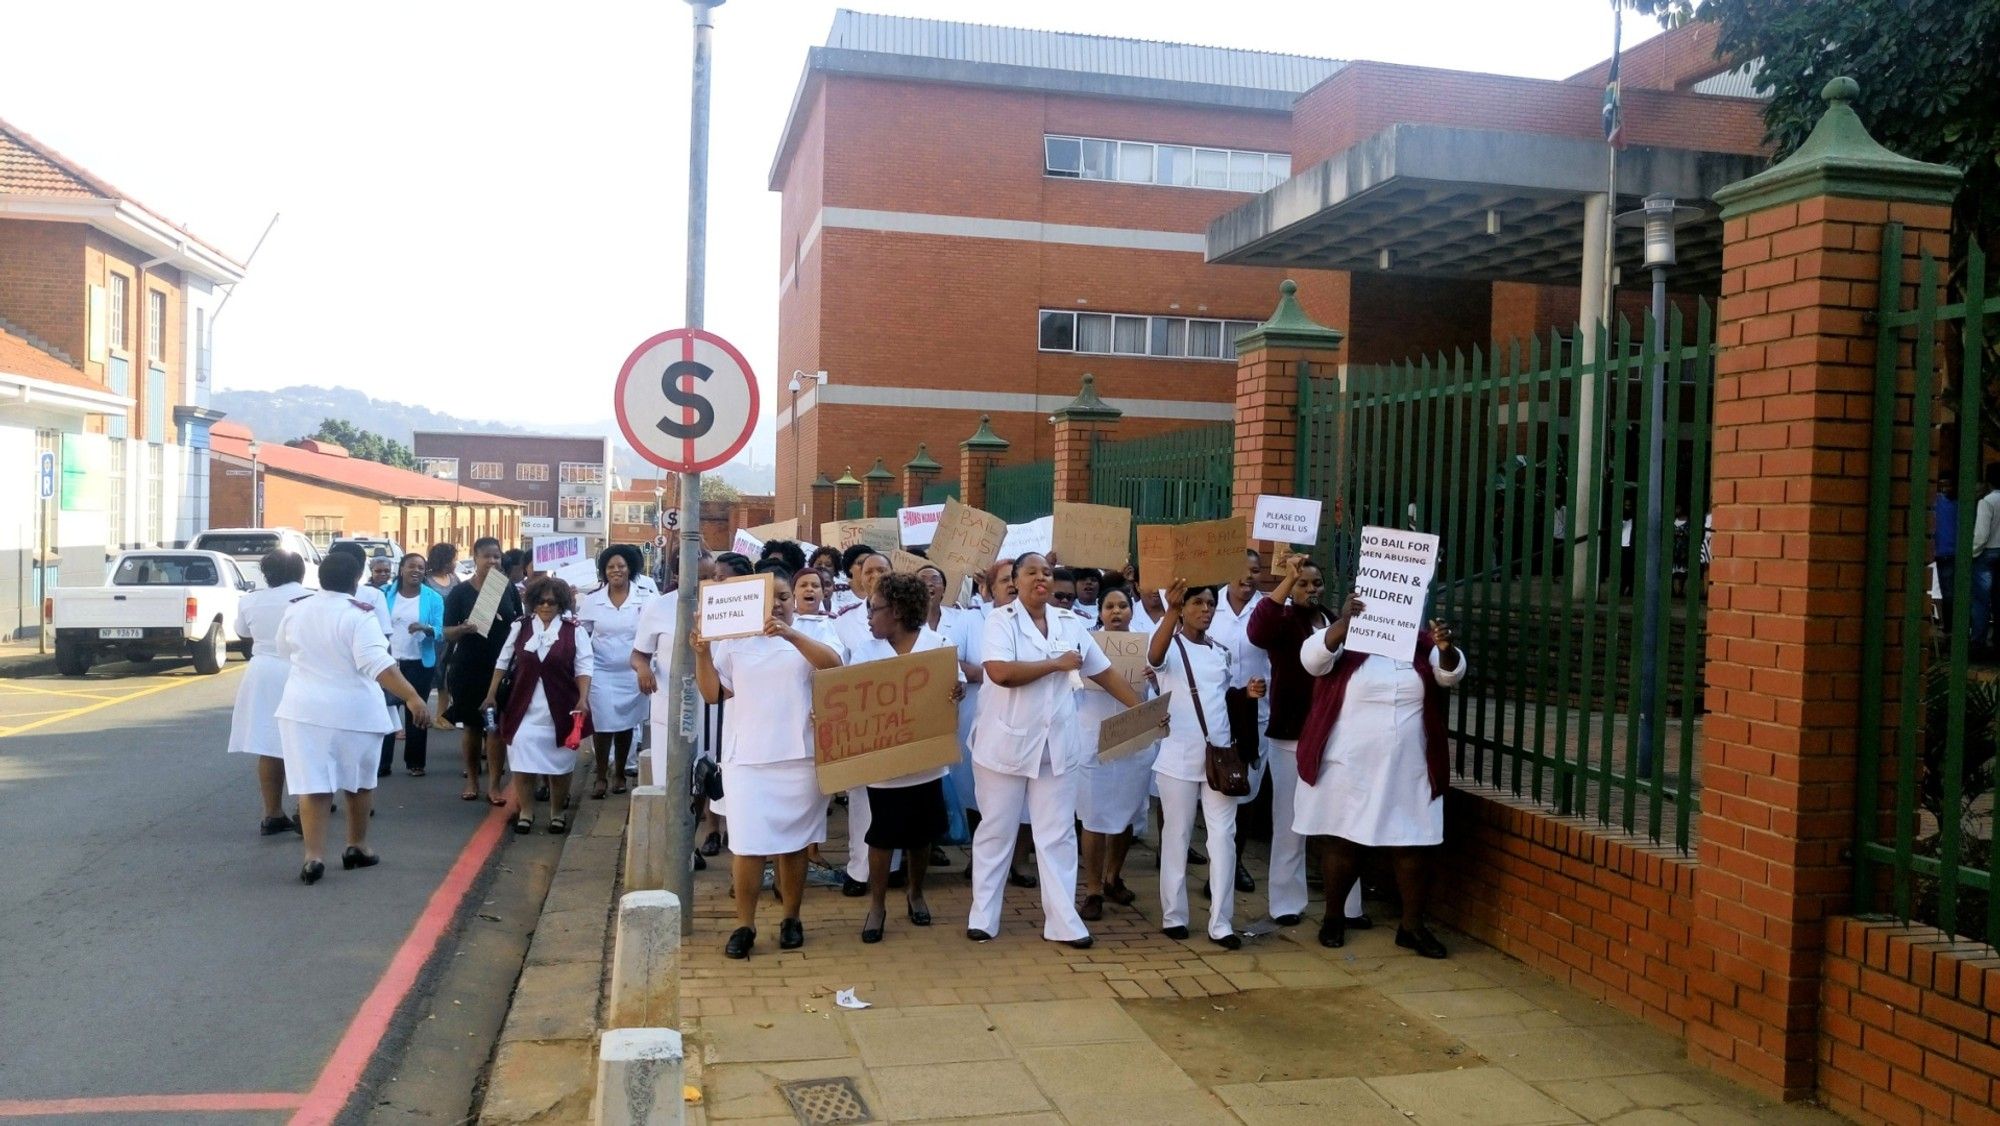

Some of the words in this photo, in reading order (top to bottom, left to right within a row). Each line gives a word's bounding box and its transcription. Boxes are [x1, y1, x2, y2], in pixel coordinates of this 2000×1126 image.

[656, 361, 715, 439] S
[1266, 512, 1292, 521] PLEASE
[1281, 524, 1295, 532] KILL
[1298, 525, 1308, 533] US
[1361, 535, 1378, 545] NO
[1381, 537, 1405, 550] BAIL
[1407, 542, 1430, 553] FOR
[1360, 550, 1382, 559] MEN
[1384, 553, 1427, 565] ABUSING
[1359, 566, 1409, 584] WOMEN
[1411, 576, 1422, 587] &
[707, 596, 714, 605] #
[715, 595, 742, 605] ABUSIVE
[743, 593, 759, 601] MEN
[1355, 585, 1413, 606] CHILDREN
[707, 612, 727, 621] MUST
[729, 610, 745, 618] FALL
[1362, 613, 1396, 626] ABUSIVE
[1397, 620, 1417, 630] MEN
[1350, 626, 1375, 637] MUST
[1377, 630, 1396, 642] FALL
[1104, 636, 1140, 656] NO
[824, 665, 930, 721] STOP
